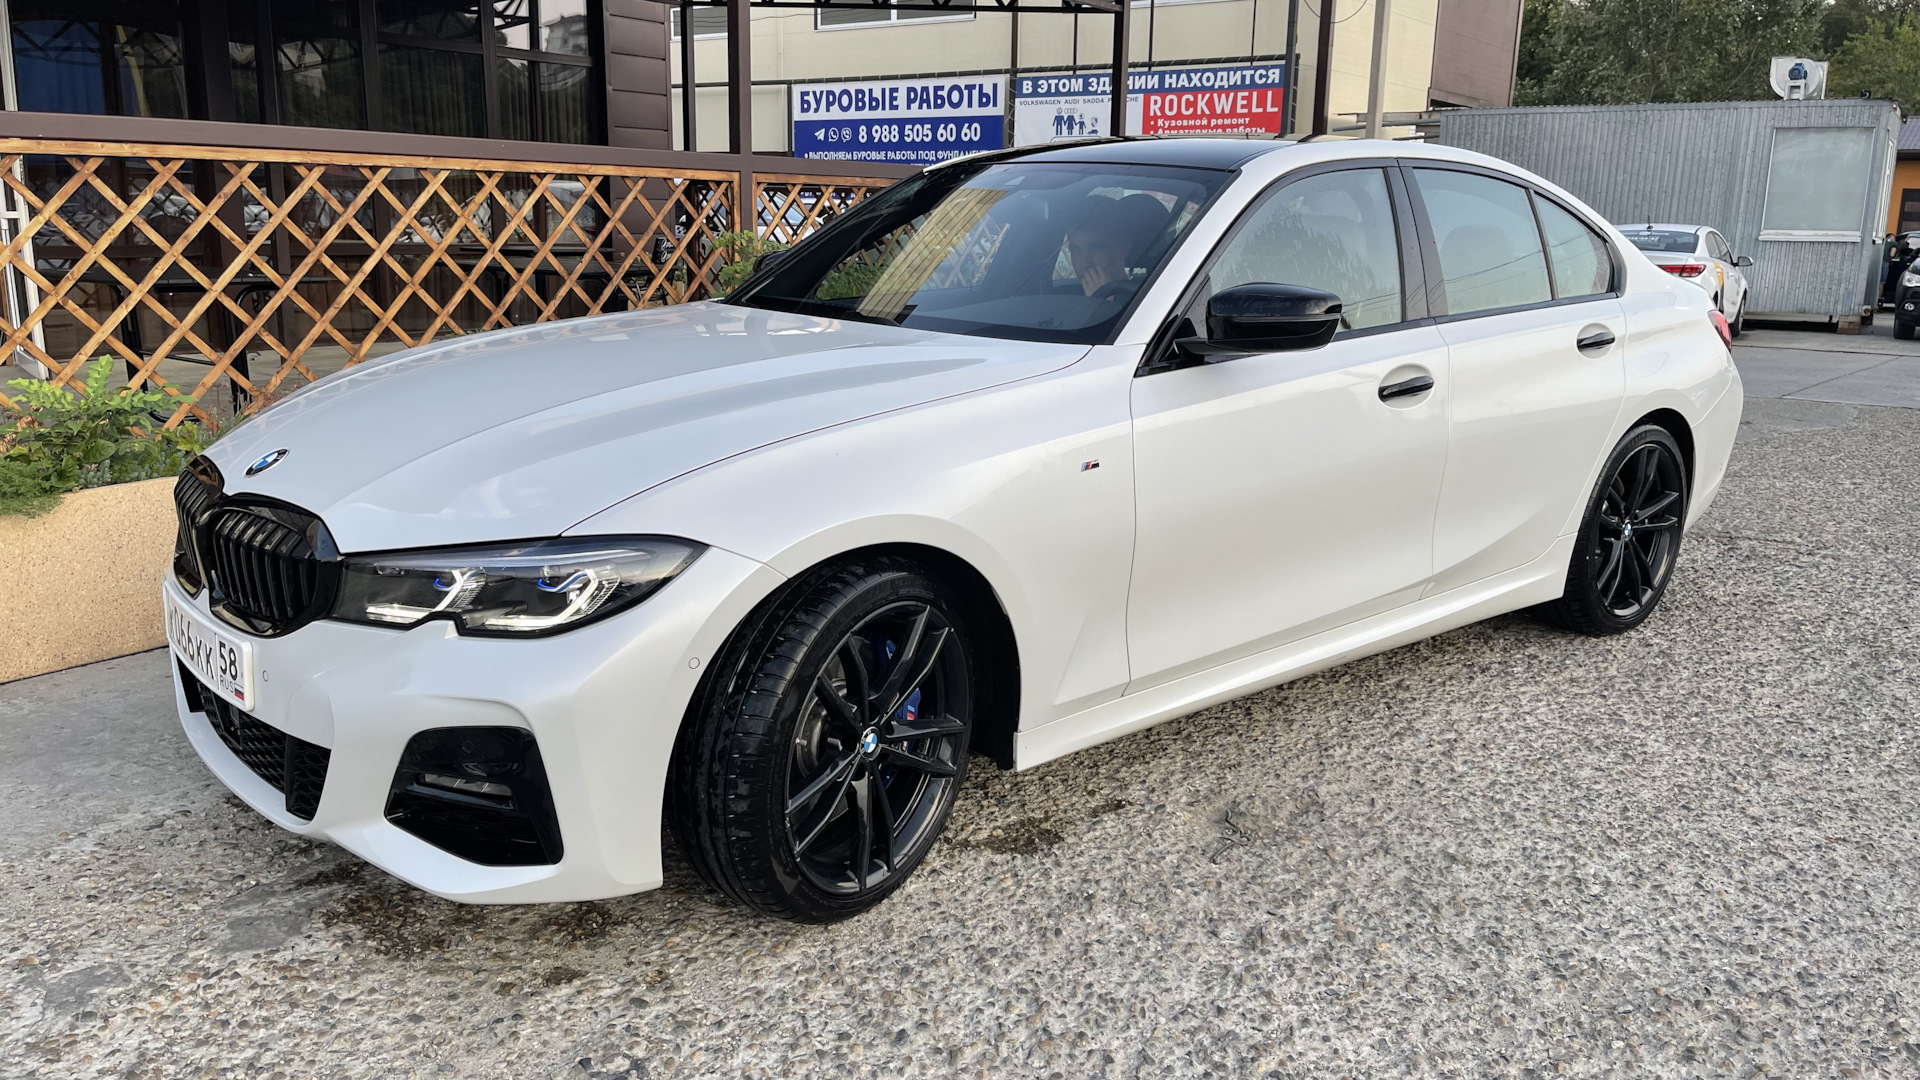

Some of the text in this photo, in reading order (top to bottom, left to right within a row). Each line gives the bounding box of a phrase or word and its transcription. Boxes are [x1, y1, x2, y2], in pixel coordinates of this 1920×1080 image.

[1022, 68, 1280, 94] В ЭТОМ ЗДНИИ НАХОДИТСЯ
[800, 83, 998, 114] БУРОВЫЕ РАБОТЫ
[1150, 90, 1279, 117] ROCKWELL
[858, 122, 980, 143] 8 988 505 60 60
[1157, 117, 1250, 129] Кузовной ремонт
[809, 151, 852, 160] ВЫПОЛНЯЕМ
[853, 151, 886, 160] БУРОВЫЕ
[887, 151, 916, 160] РАБОТЫ
[918, 150, 936, 161] ПОД
[219, 640, 238, 681] 58
[220, 674, 235, 694] RUS
